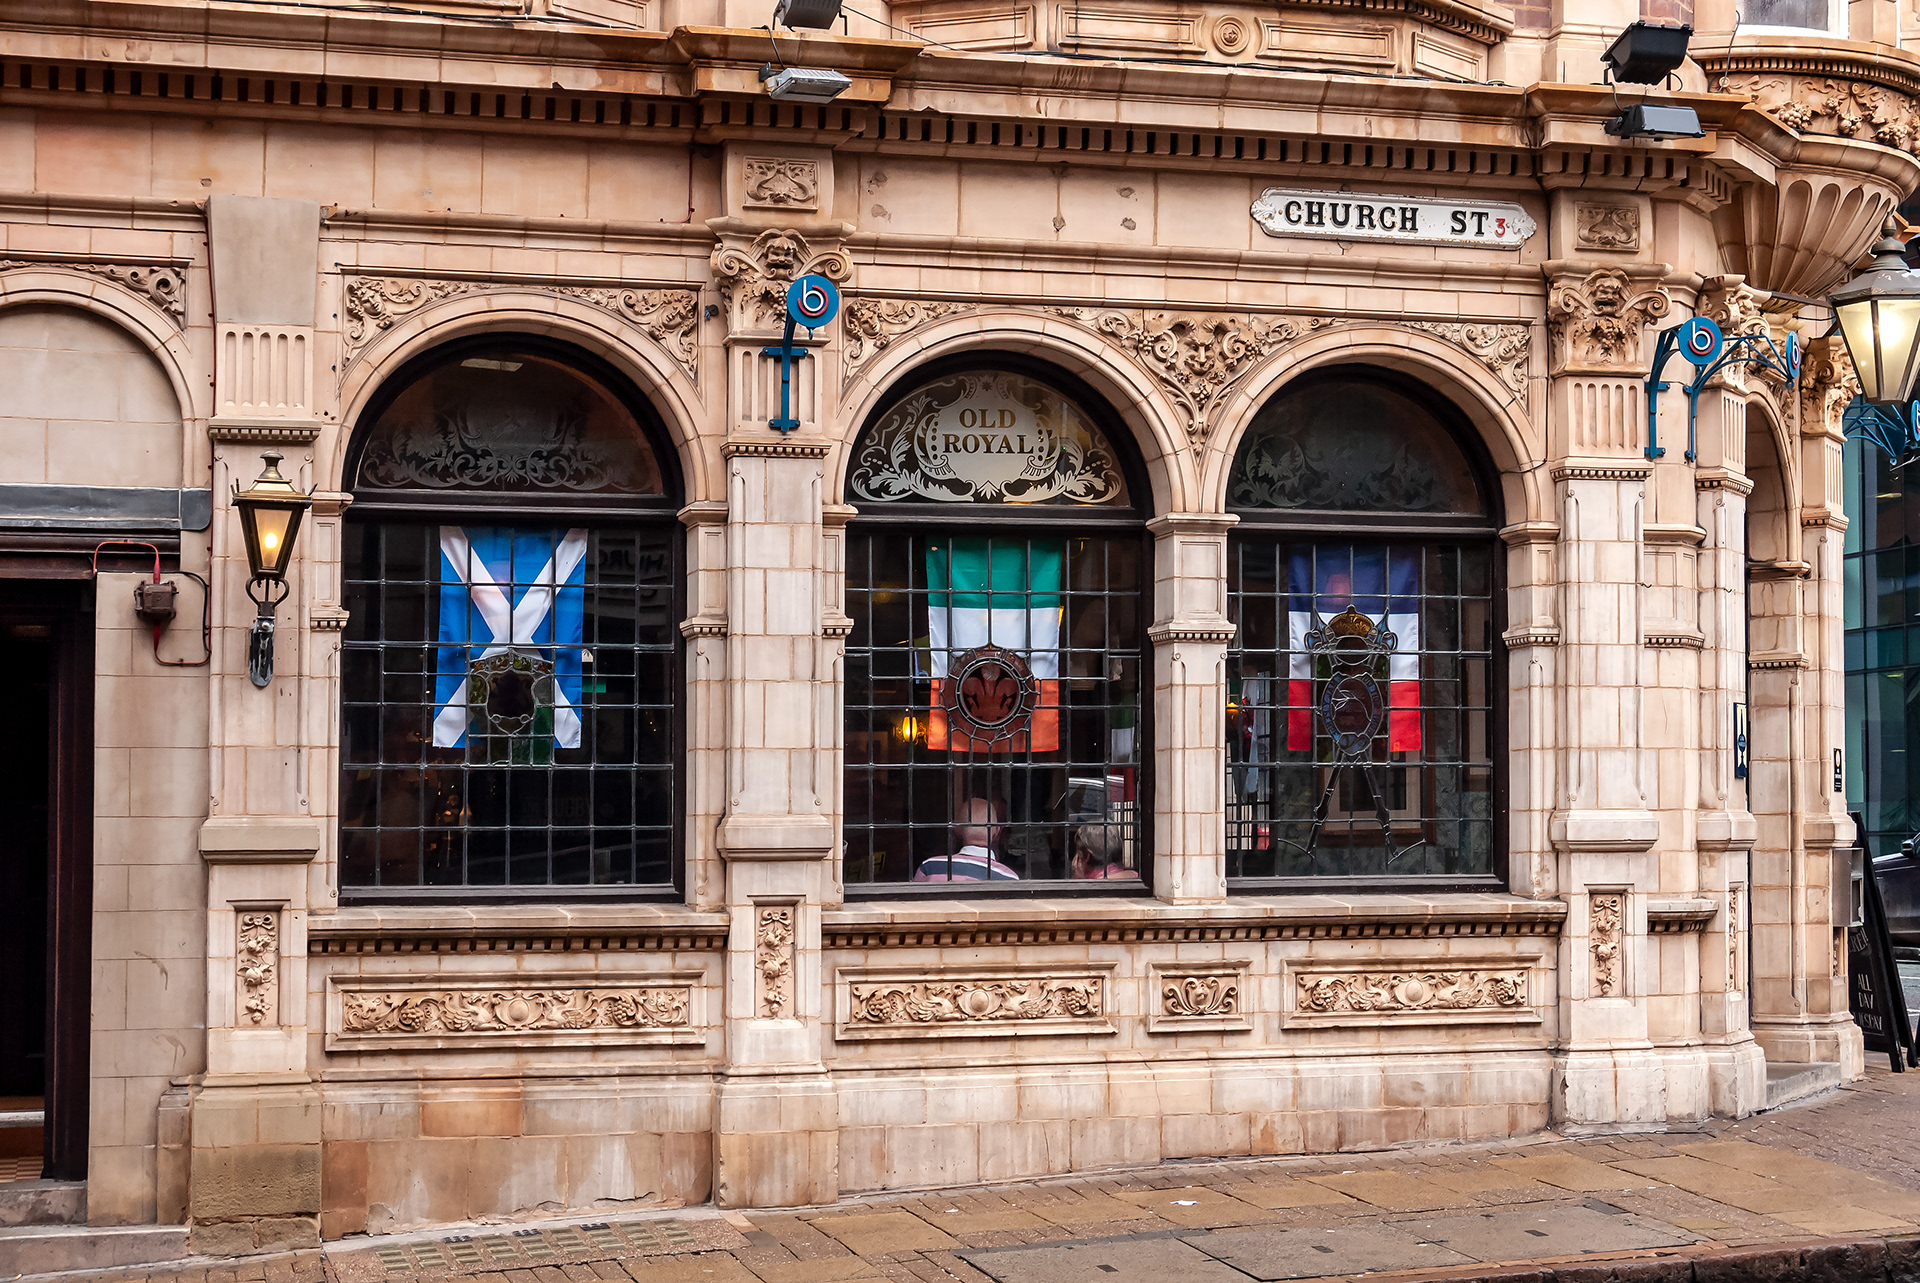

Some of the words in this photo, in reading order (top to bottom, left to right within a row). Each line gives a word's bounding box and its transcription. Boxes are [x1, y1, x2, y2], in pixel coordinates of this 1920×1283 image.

[1284, 201, 1418, 232] CHURCH
[1450, 211, 1489, 236] ST
[1496, 218, 1507, 237] 3
[959, 408, 1017, 429] OLD
[942, 433, 1034, 454] ROYAL
[1858, 973, 1872, 992] ALL
[1858, 992, 1873, 1009] DAY
